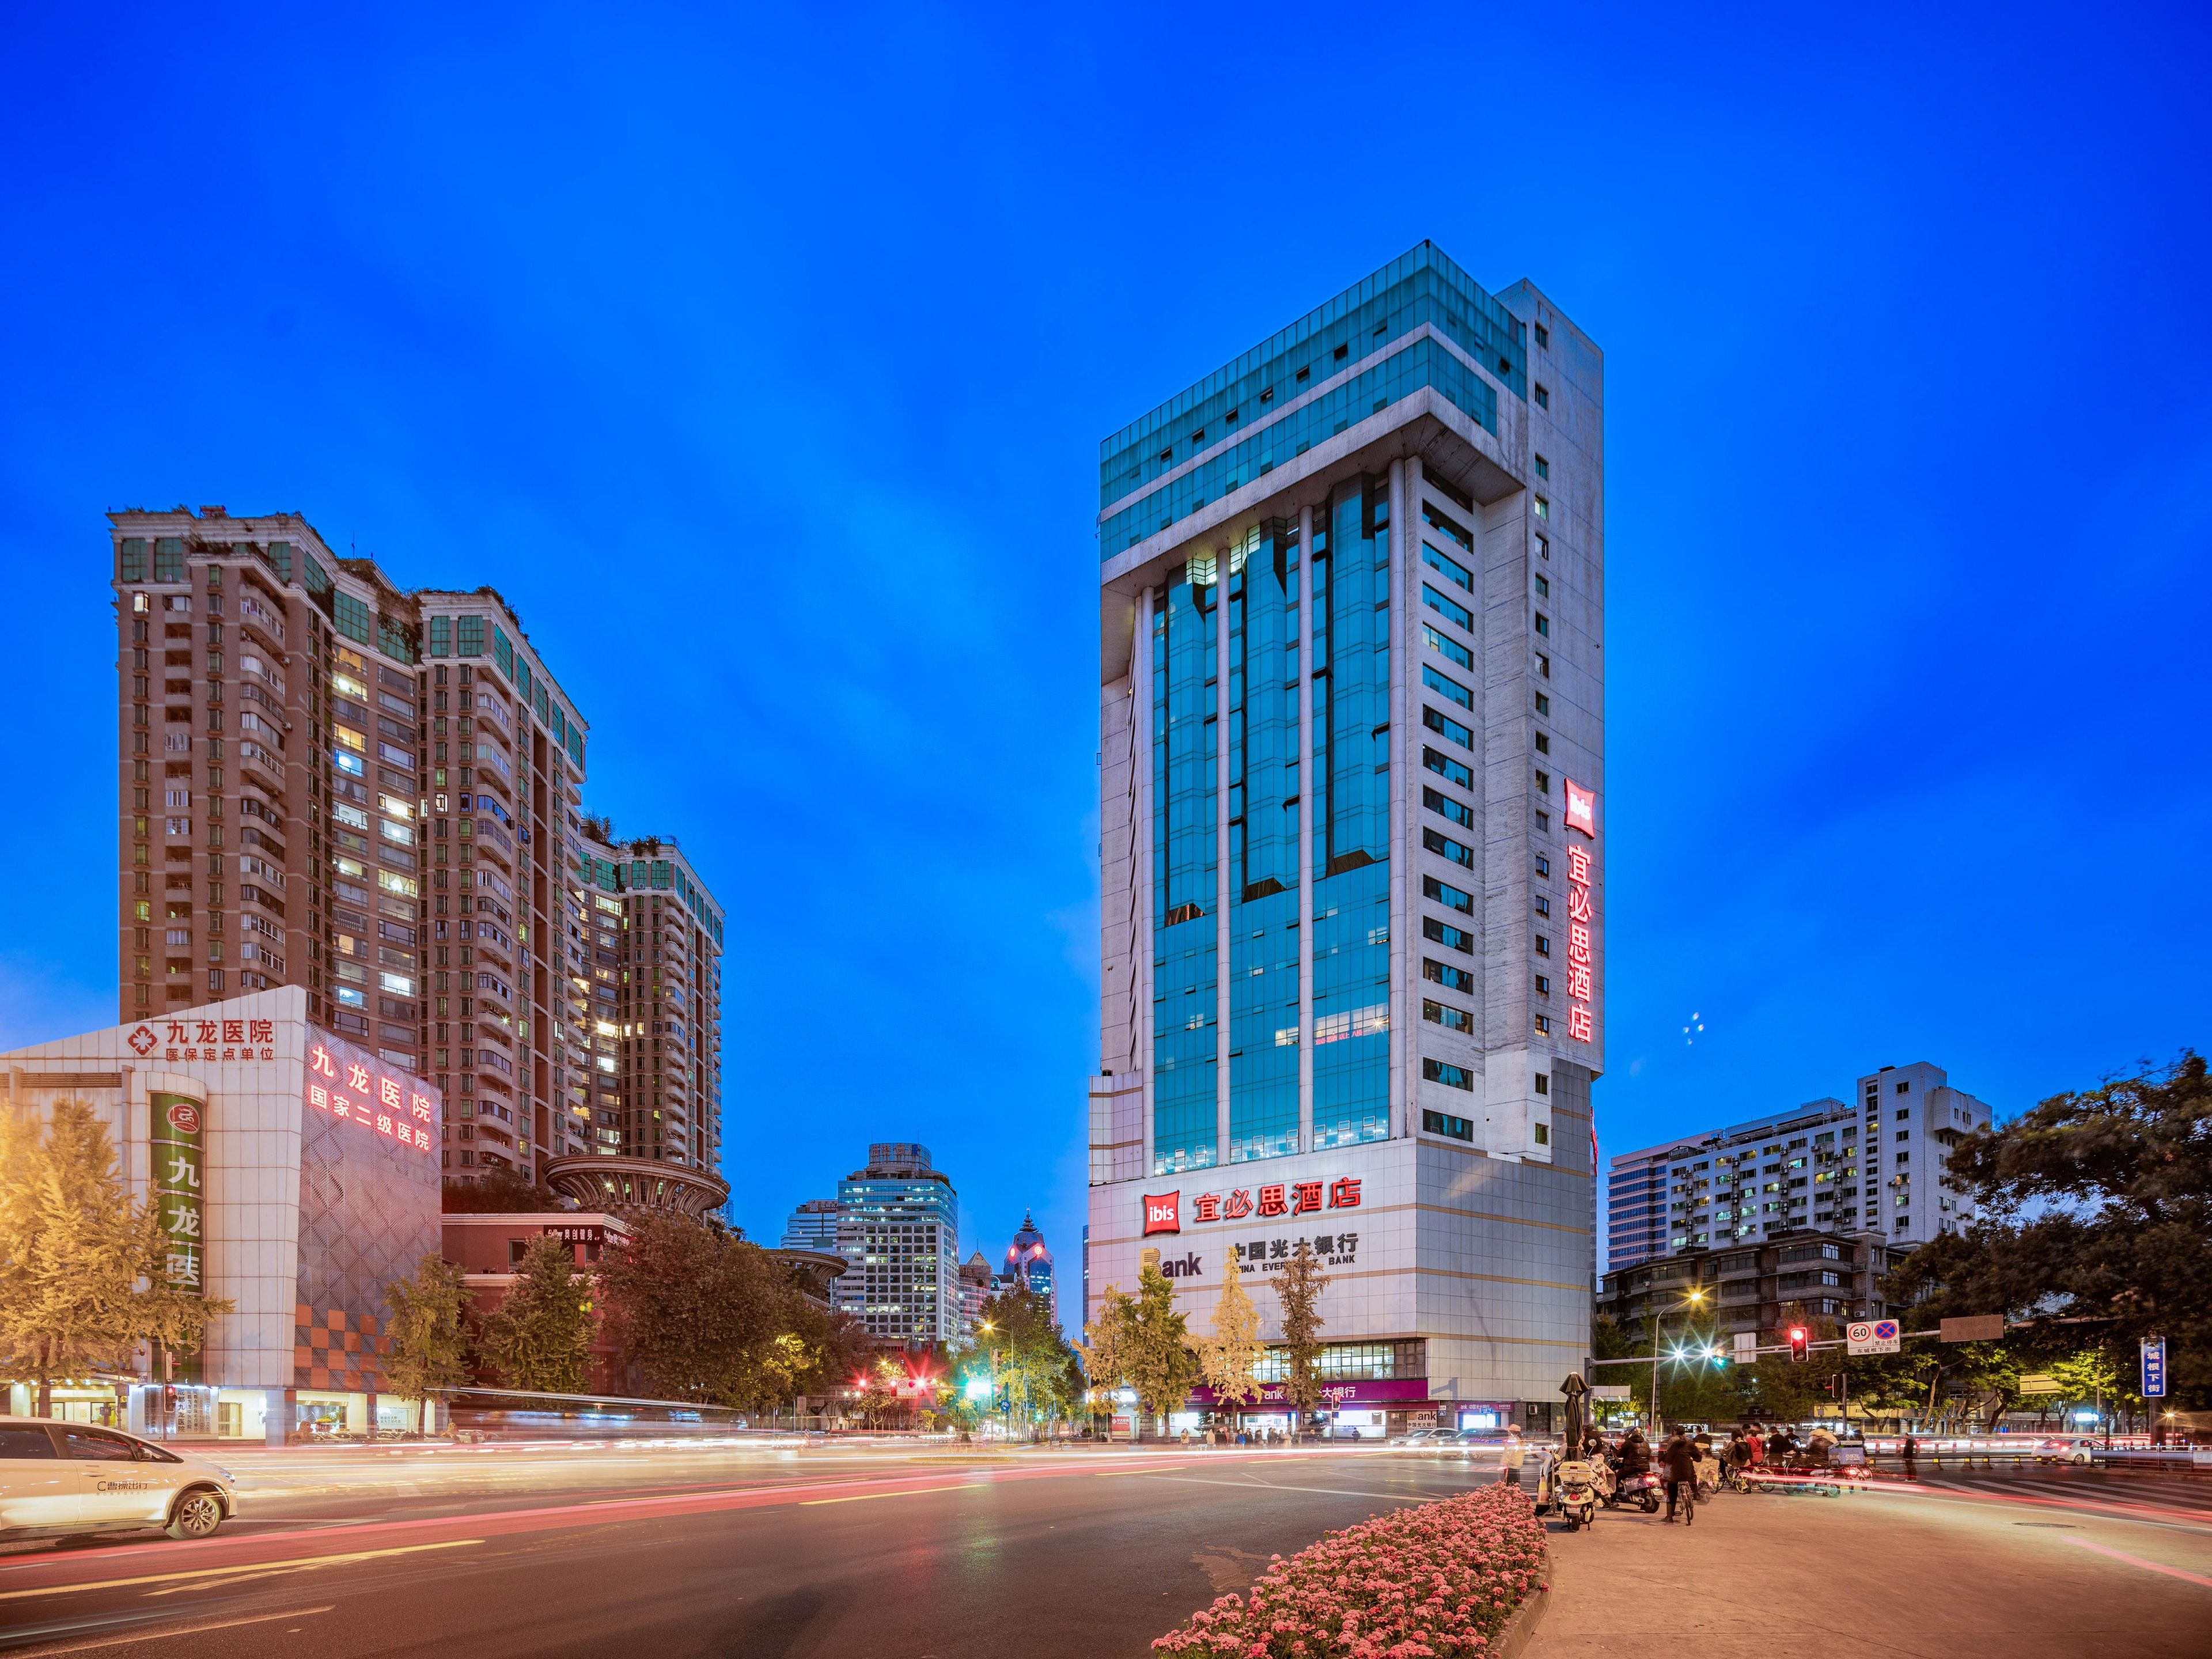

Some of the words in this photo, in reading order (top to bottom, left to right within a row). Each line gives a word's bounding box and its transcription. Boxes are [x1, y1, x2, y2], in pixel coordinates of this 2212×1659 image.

[1567, 846, 1592, 1043] 宜必思酒店
[167, 1019, 274, 1044] 九龙医院
[166, 1047, 274, 1061] 医保定点单位
[312, 1046, 431, 1123] 九龙医院
[310, 1084, 429, 1151] 国家二级医院
[1195, 1177, 1361, 1222] 宜必思酒店
[166, 1156, 200, 1286] 九龙医
[1149, 1205, 1175, 1222] ibis
[1329, 1255, 1355, 1266] BANK
[1853, 1328, 1867, 1337] 60
[2147, 1344, 2160, 1392] 城根下街
[1264, 1389, 1284, 1400] ank
[108, 1481, 148, 1490] 曹操出行
